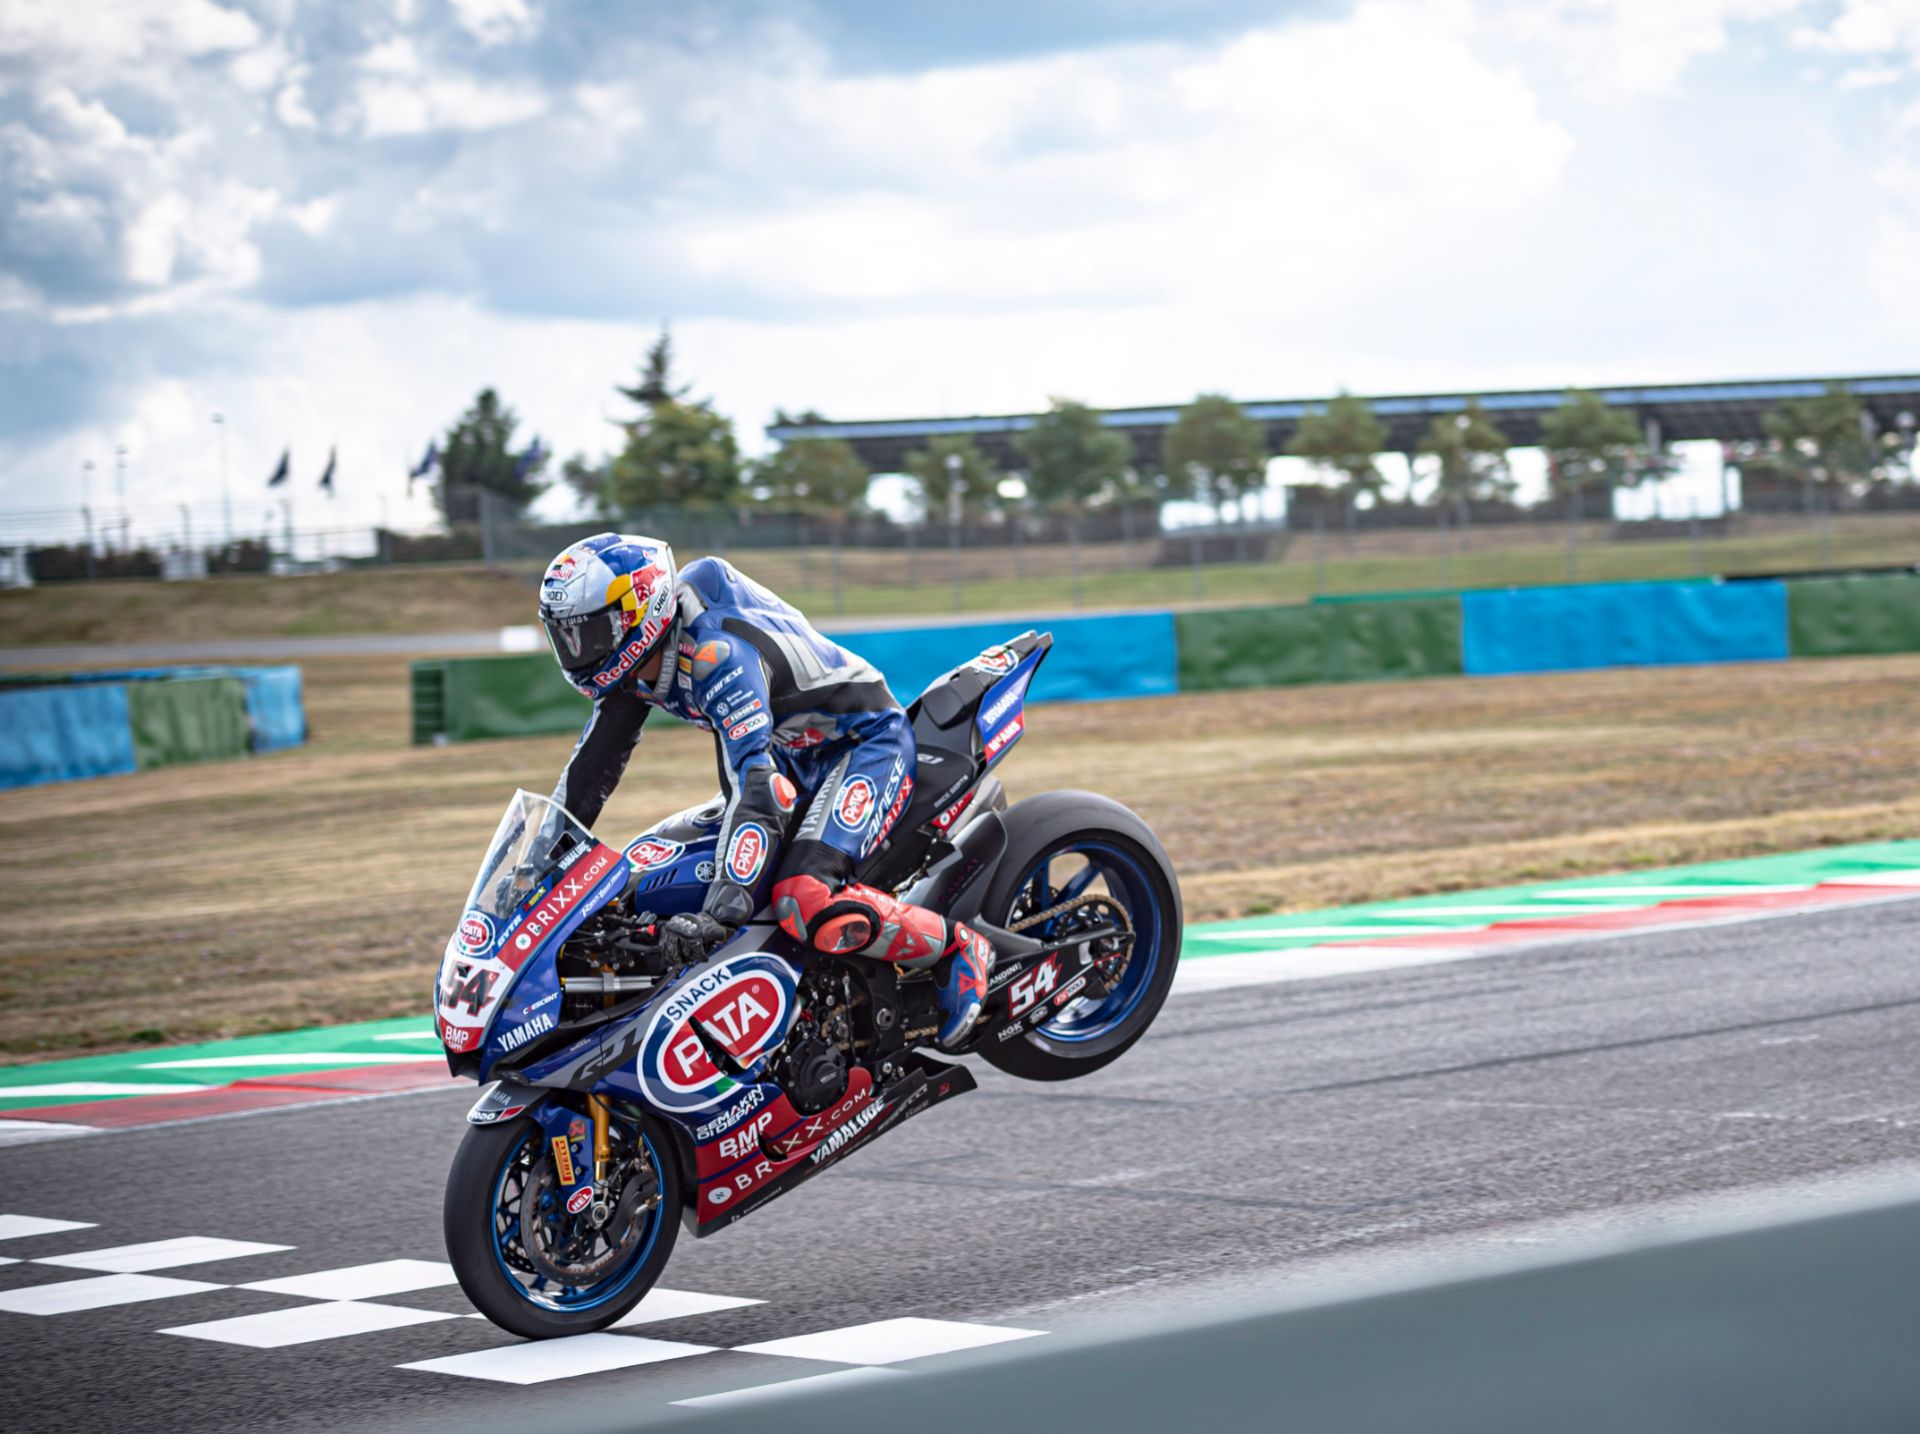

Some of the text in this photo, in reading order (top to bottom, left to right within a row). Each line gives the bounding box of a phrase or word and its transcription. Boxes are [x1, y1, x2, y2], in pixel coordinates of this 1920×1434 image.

[593, 620, 658, 686] Red Bull
[656, 650, 676, 694] YAMAHA
[706, 665, 744, 701] DAINESE
[796, 764, 841, 836] YAMAHA
[844, 786, 867, 821] PATA
[861, 752, 906, 859] DAINESE
[736, 836, 759, 873] PATA
[464, 923, 483, 942] PATA
[497, 913, 523, 949] GYTR
[440, 960, 500, 1018] 54
[523, 991, 559, 1015] CRESCENT
[667, 969, 730, 1021] SNACK
[1010, 952, 1061, 1019] 54
[445, 1025, 469, 1044] BMP
[497, 1013, 554, 1053] YAMAHA
[998, 1021, 1023, 1039] NGK
[696, 1084, 764, 1132] SEMAKIN
[716, 1092, 765, 1134] DEPAN
[719, 1111, 773, 1158] BMP
[809, 1096, 885, 1165] YAMALUBE
[555, 1140, 573, 1182] PIRELLI
[570, 1192, 590, 1211] HEL
